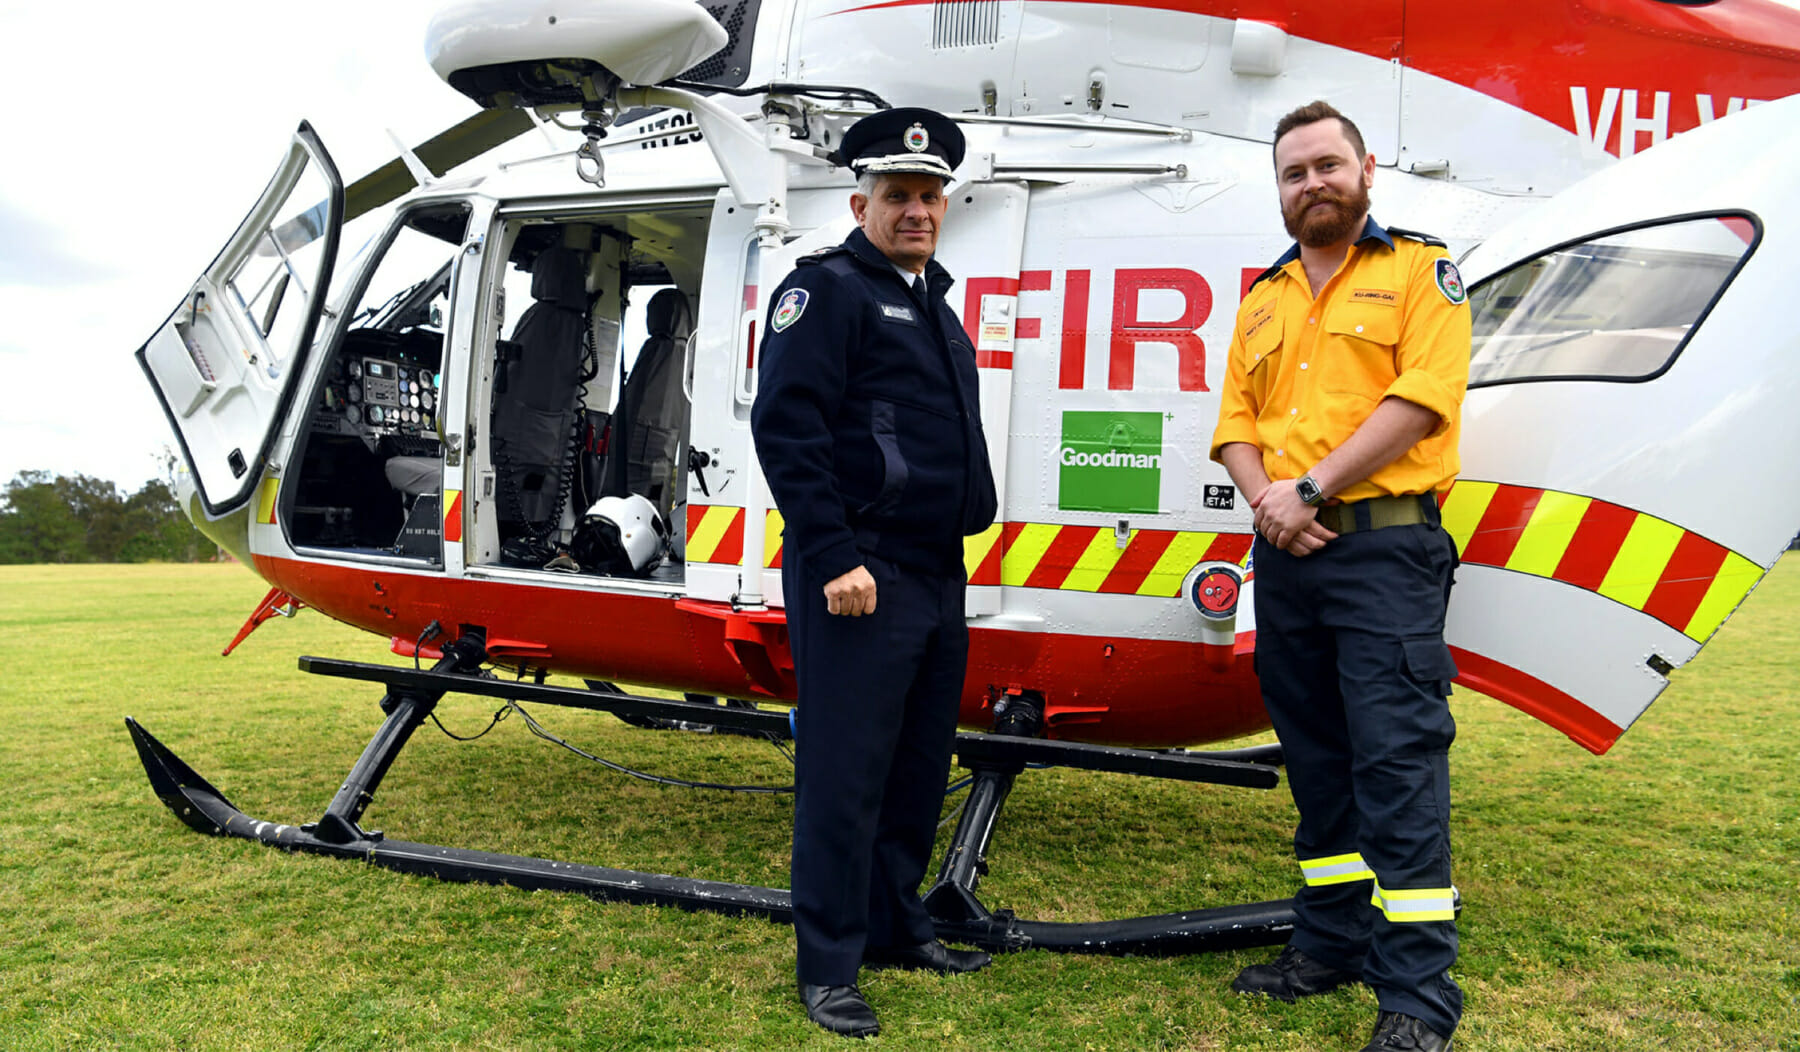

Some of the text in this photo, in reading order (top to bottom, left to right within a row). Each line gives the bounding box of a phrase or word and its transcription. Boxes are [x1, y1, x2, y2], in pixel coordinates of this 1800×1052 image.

[962, 267, 1271, 392] FIR
[1060, 447, 1161, 469] Goodman
[1205, 497, 1233, 508] JET A-1
